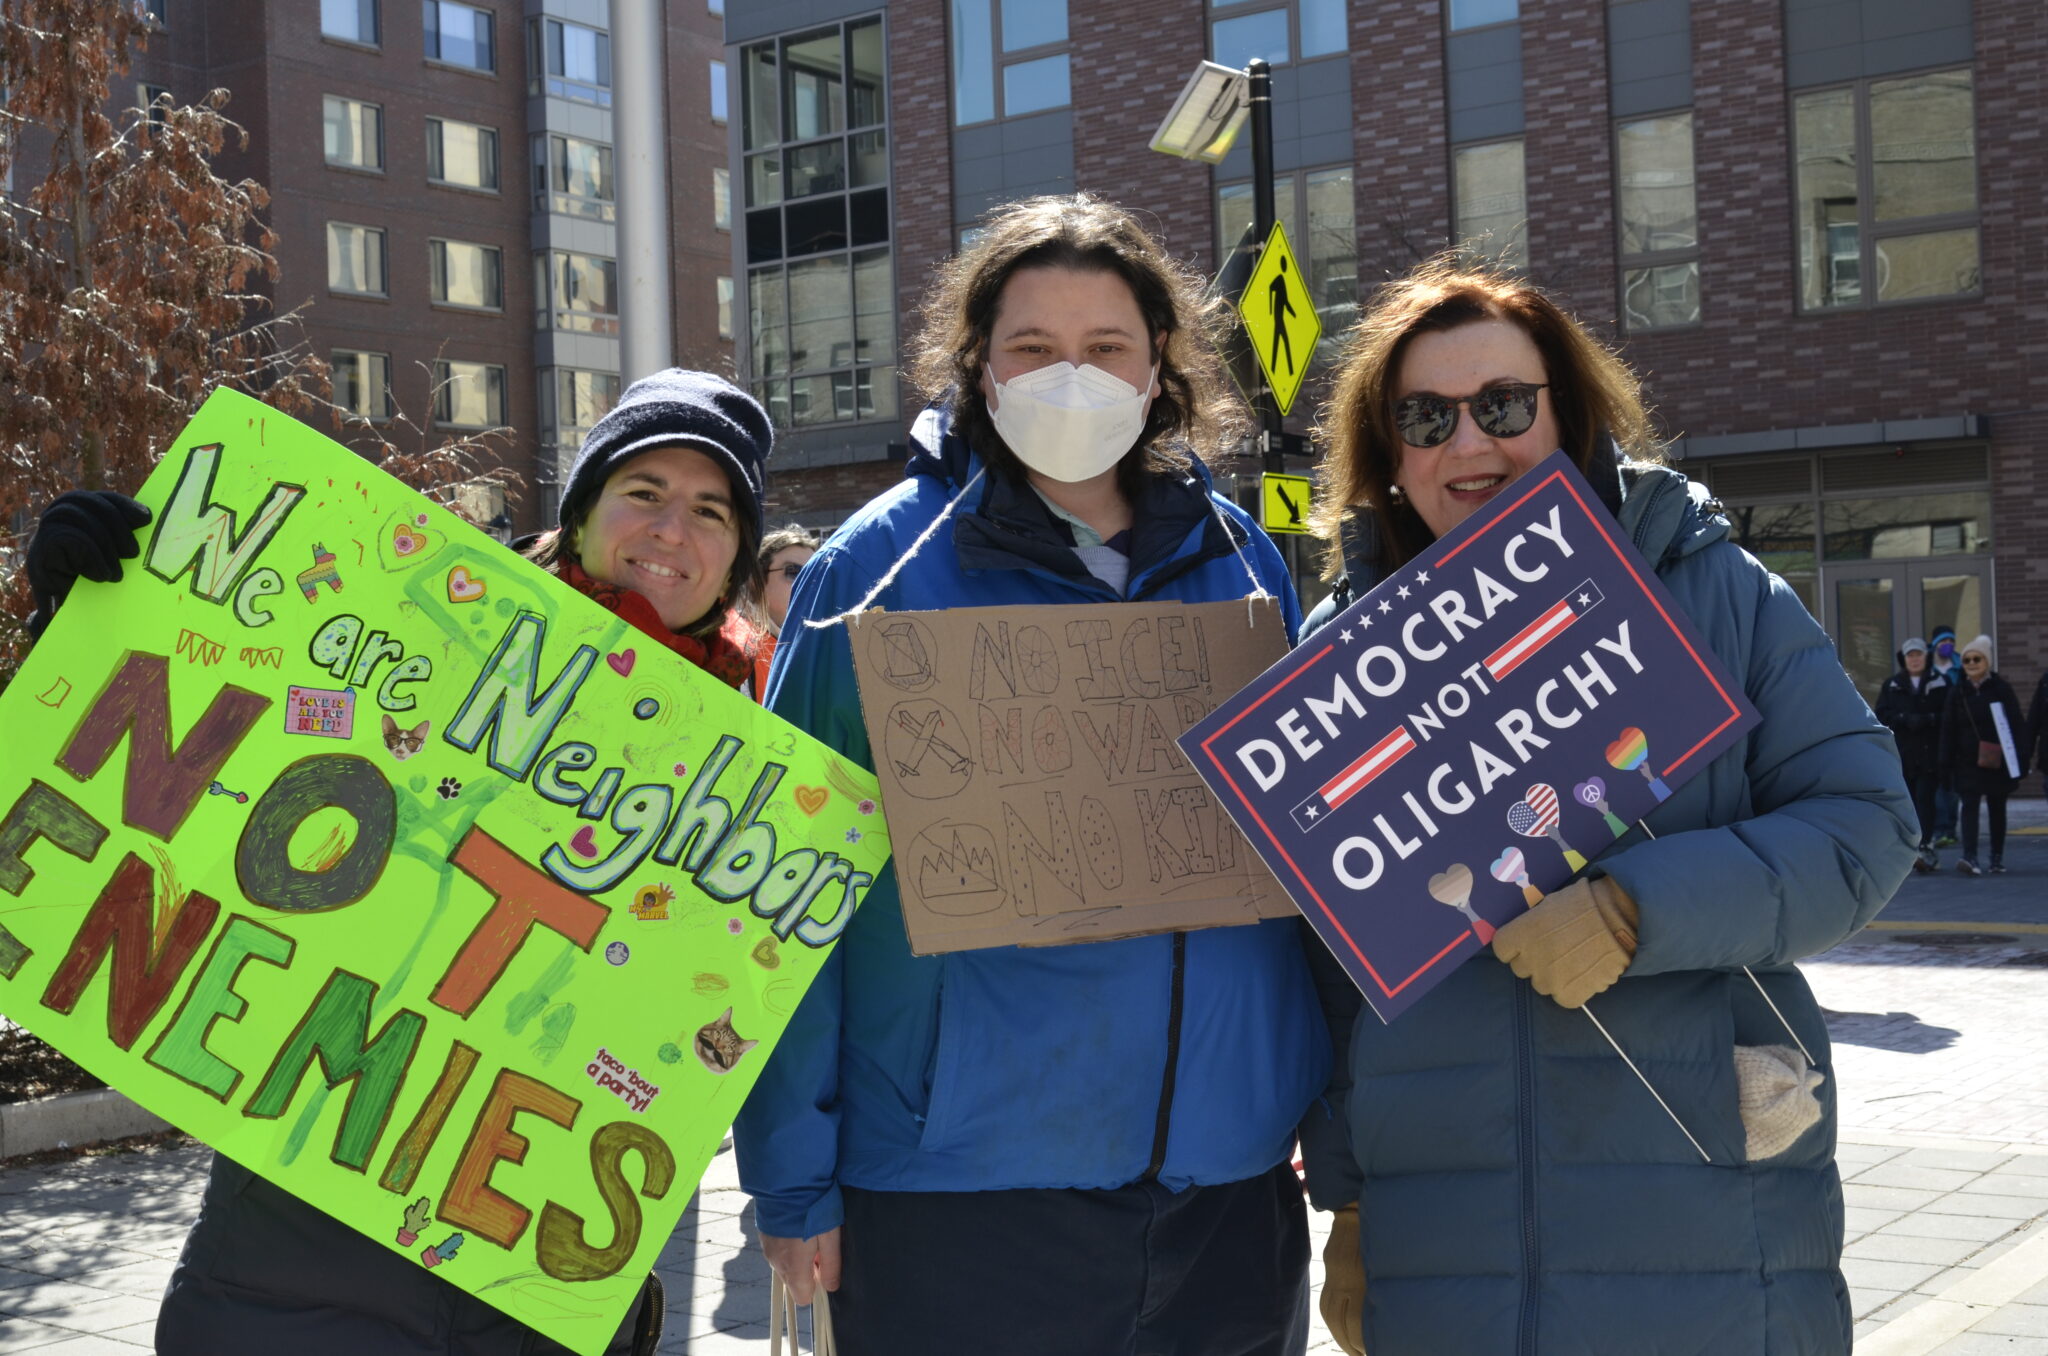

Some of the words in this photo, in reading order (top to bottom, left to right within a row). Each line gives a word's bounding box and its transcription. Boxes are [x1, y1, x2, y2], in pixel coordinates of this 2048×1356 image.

[969, 619, 1060, 700] NO
[1065, 616, 1213, 702] ICE!
[1235, 504, 1575, 792] DEMOCRACY
[143, 442, 307, 628] We
[309, 614, 432, 711] are
[443, 609, 873, 949] Neighbors
[297, 717, 343, 732] NEED
[299, 696, 330, 708] LOVE
[331, 697, 346, 709] IS
[299, 708, 320, 718] ALL
[322, 709, 345, 718] YOU
[978, 703, 1072, 775] NO
[1072, 695, 1217, 781] WAR
[1407, 661, 1491, 742] NOT
[1332, 620, 1645, 890] OLIGARCHY
[54, 648, 611, 1020] NOT
[1002, 791, 1123, 917] NO
[0, 778, 677, 1282] ENEMIES
[597, 1048, 625, 1075] taco
[587, 1063, 600, 1078] a
[596, 1072, 651, 1112] party!
